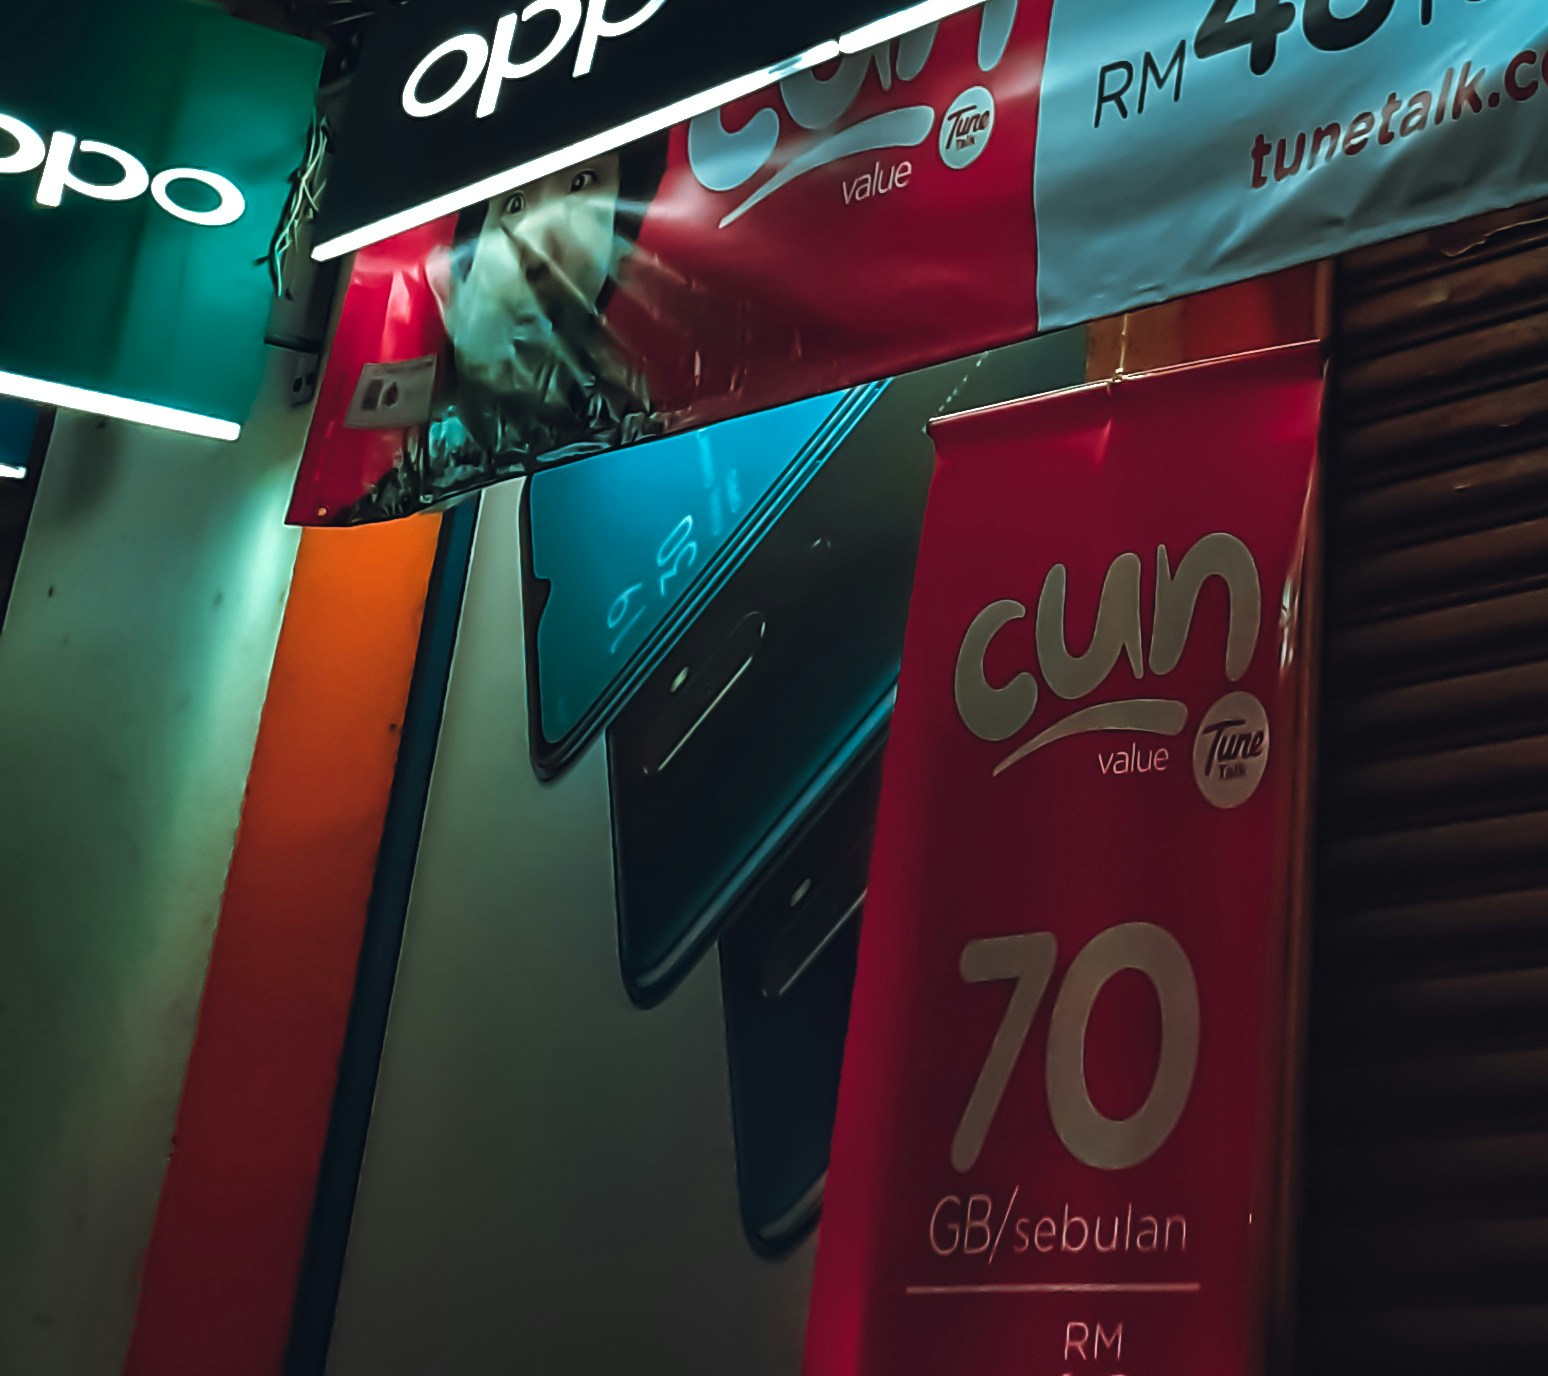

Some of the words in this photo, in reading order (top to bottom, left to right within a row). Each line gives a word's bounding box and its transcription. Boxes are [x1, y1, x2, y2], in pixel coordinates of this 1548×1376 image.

[1093, 38, 1188, 128] RM
[841, 160, 913, 205] value
[953, 531, 1263, 743] cun
[1097, 741, 1170, 779] value
[1202, 718, 1266, 777] Tune
[949, 920, 1201, 1174] 70
[928, 1184, 1188, 1265] GB/sebulan
[1063, 1320, 1125, 1361] RM
